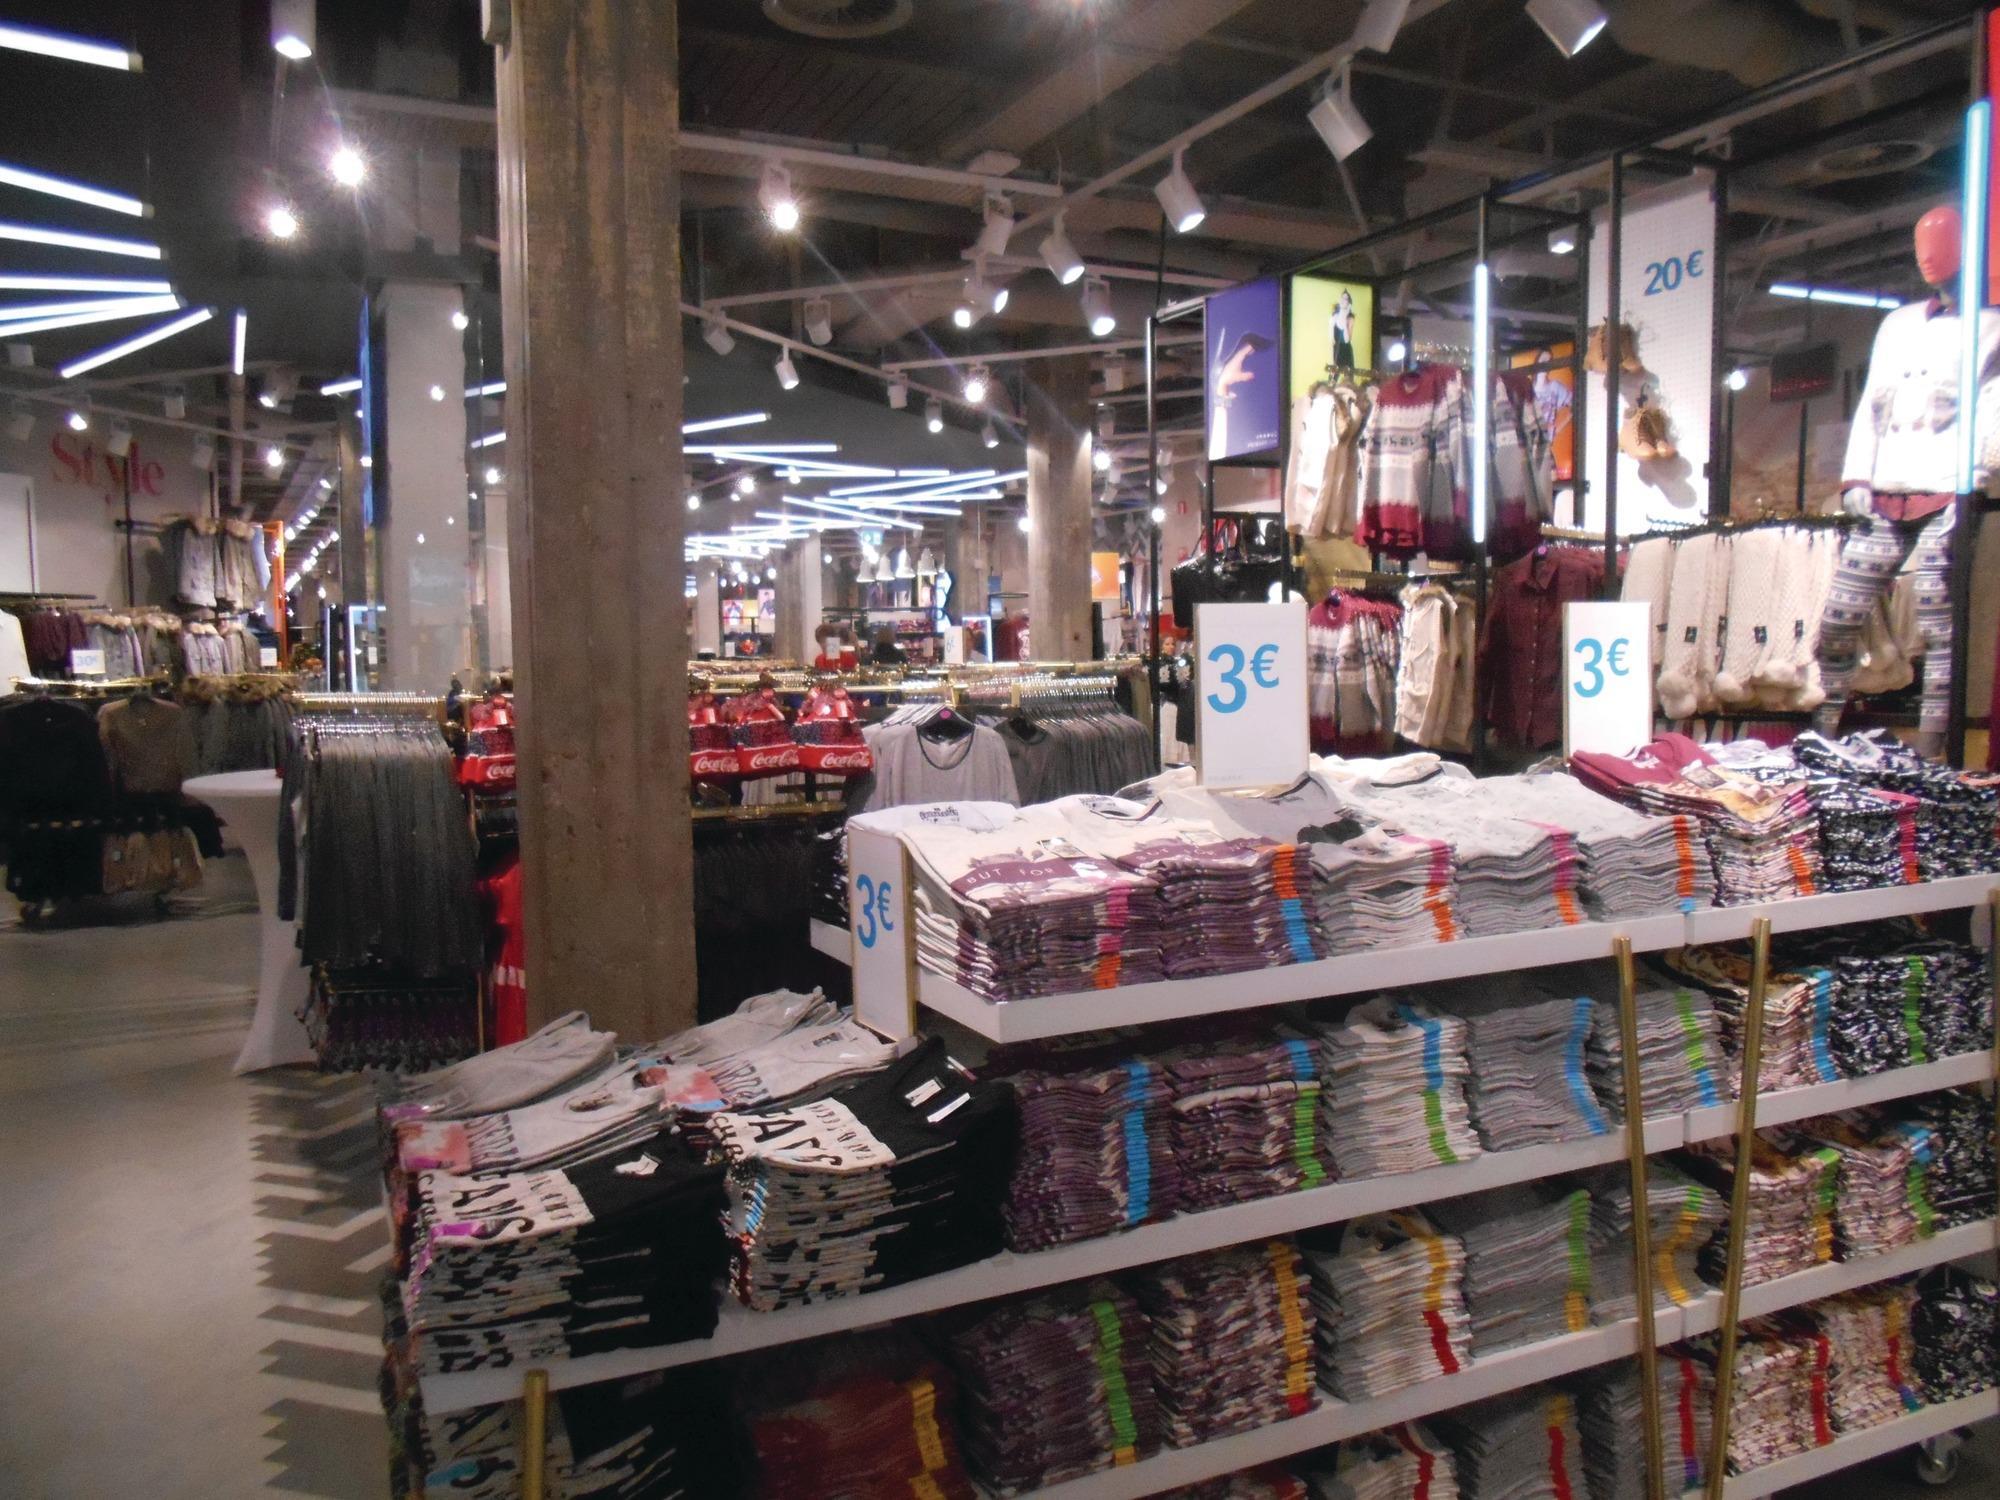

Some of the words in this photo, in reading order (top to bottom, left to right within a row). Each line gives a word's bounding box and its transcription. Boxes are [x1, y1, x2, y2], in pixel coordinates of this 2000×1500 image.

[1207, 643, 1280, 714] 3€
[1573, 637, 1630, 698] 3€
[966, 868, 1002, 885] BUT
[856, 874, 894, 949] 3€
